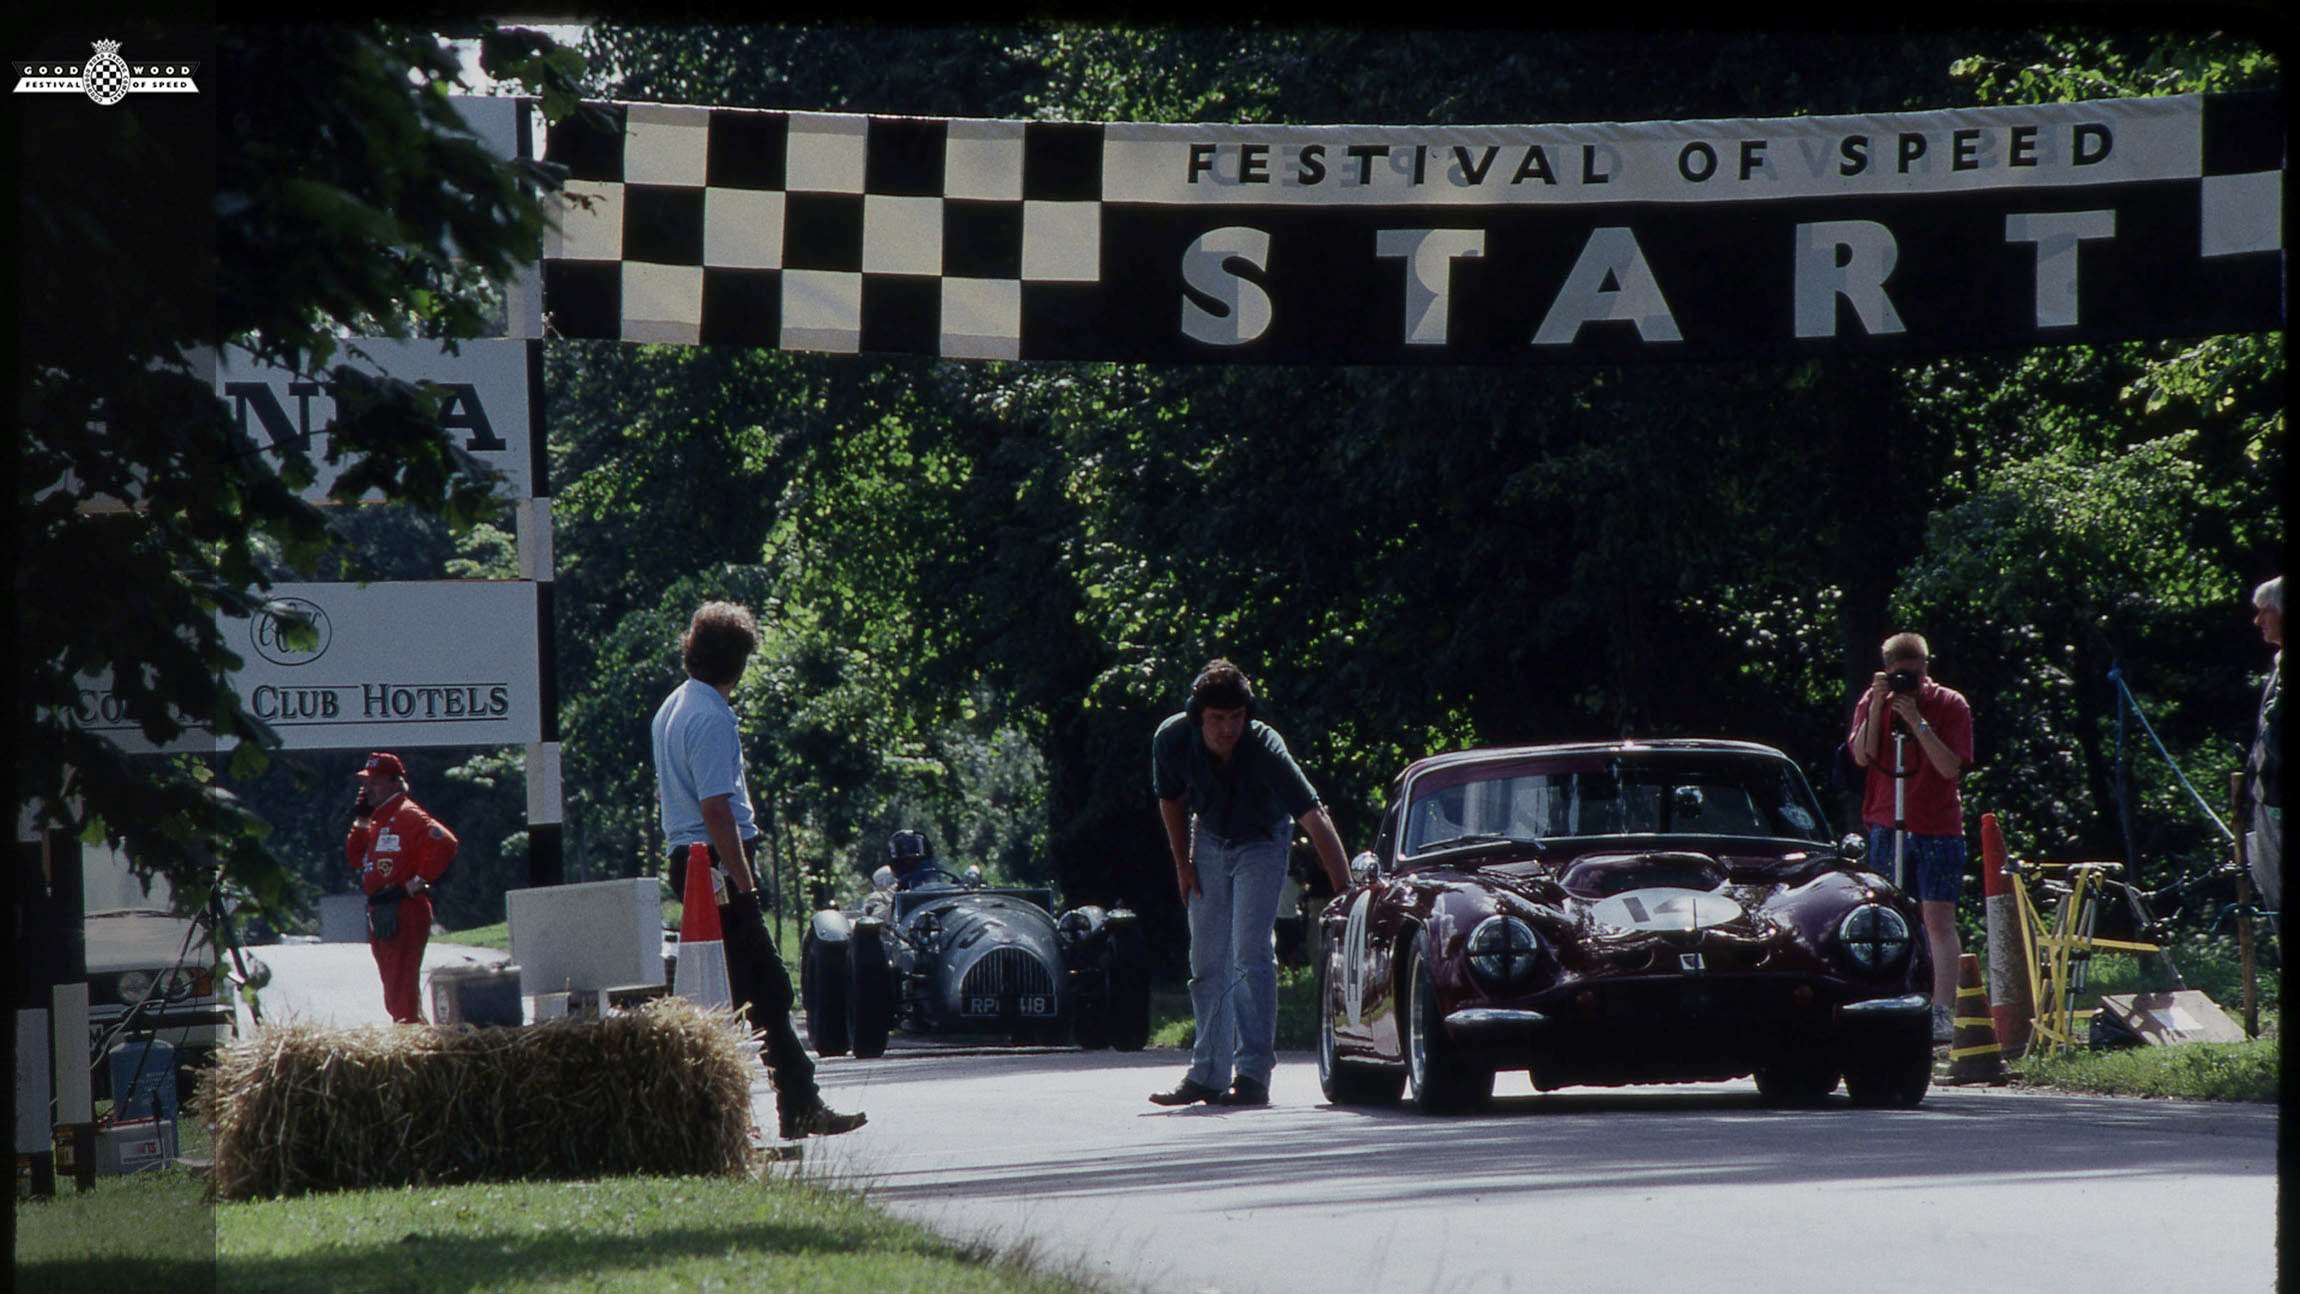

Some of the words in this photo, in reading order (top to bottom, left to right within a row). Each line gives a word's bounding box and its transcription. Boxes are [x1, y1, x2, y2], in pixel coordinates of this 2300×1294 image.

[1187, 143, 1610, 185] FESTIVAL
[1677, 140, 1768, 183] OF
[1838, 122, 2114, 177] SPEED
[1181, 209, 2117, 346] START
[251, 685, 339, 719] CLUB
[361, 681, 509, 718] HOTELS
